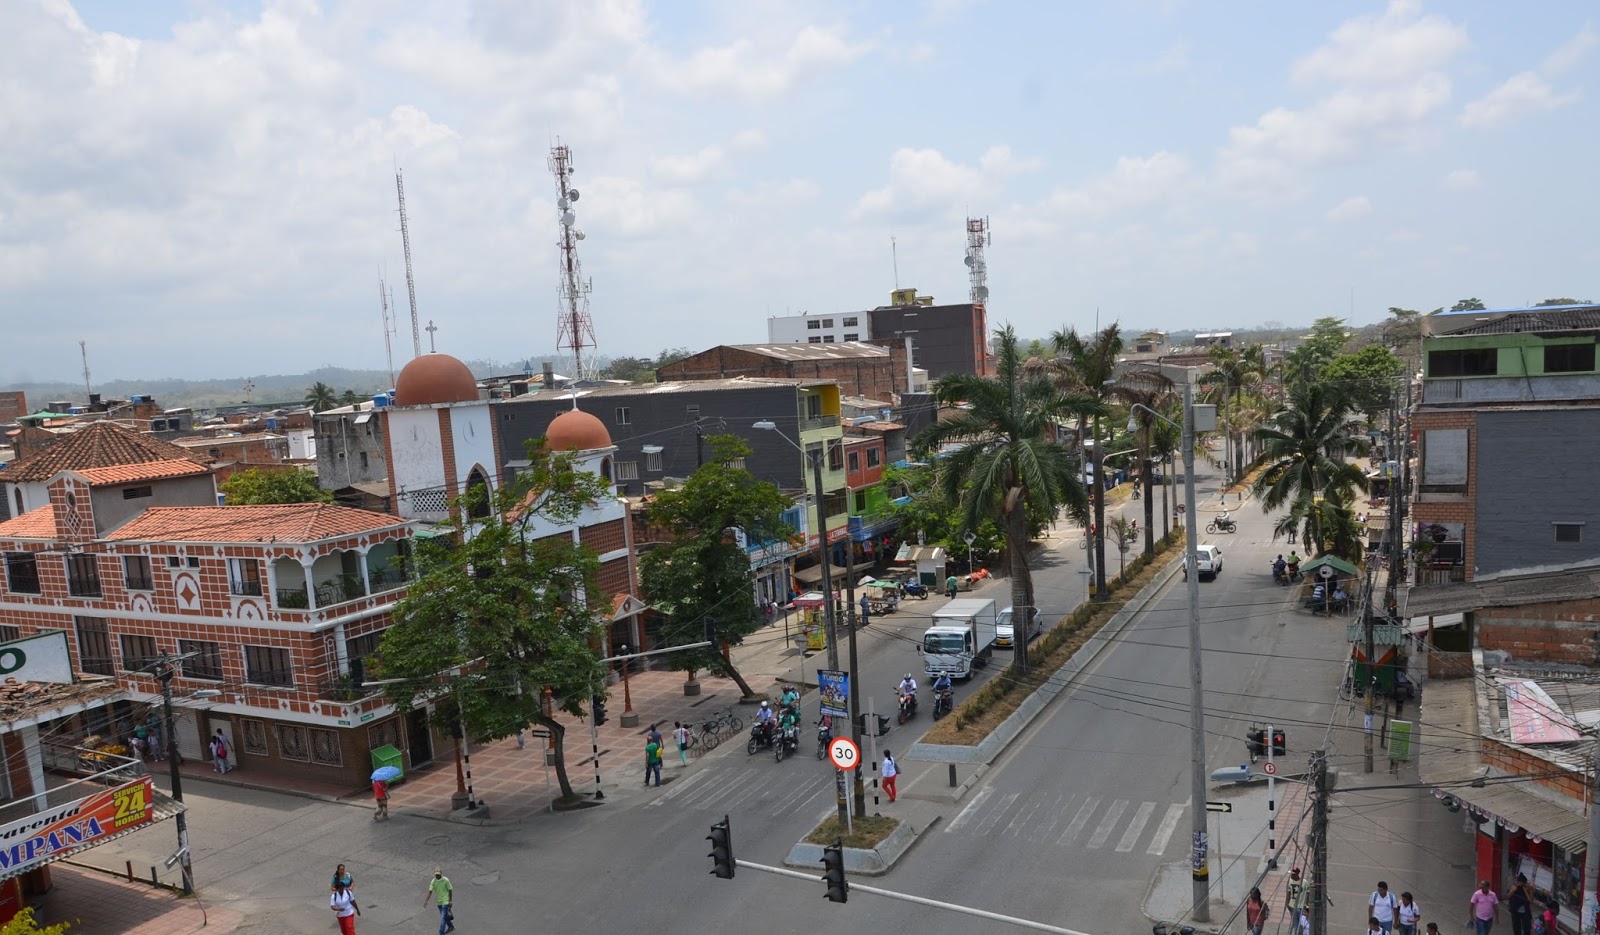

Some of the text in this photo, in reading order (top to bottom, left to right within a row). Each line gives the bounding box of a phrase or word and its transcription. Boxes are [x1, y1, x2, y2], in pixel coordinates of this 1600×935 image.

[823, 674, 844, 683] TURBO
[835, 747, 853, 760] 30
[113, 783, 145, 799] SERVICIO
[114, 790, 146, 820] 24
[114, 809, 146, 828] HORAS
[0, 816, 105, 871] MPANA
